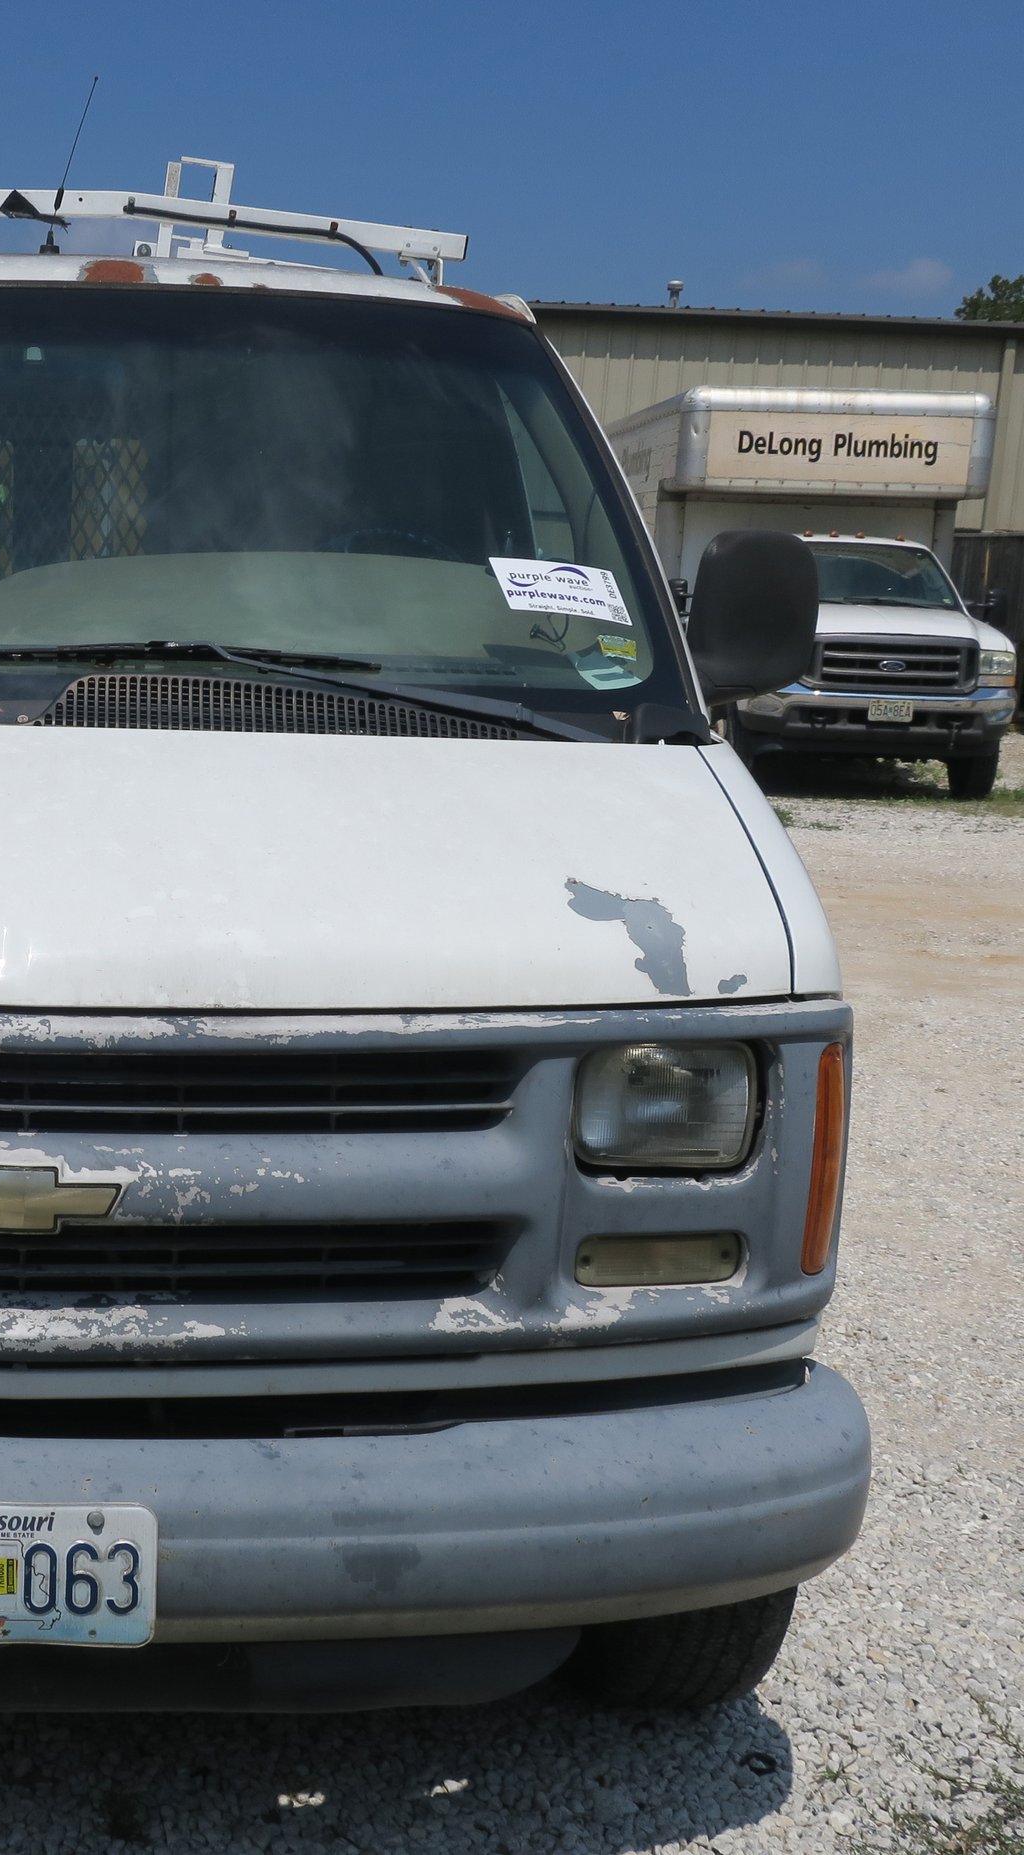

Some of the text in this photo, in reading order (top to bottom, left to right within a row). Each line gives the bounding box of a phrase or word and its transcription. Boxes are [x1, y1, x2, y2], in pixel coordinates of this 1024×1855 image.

[738, 430, 939, 466] DeLong Plumbing
[509, 571, 589, 587] purple wave
[600, 571, 617, 599] DE3799
[506, 589, 606, 607] purplewave.com
[24, 1541, 140, 1615] 063
